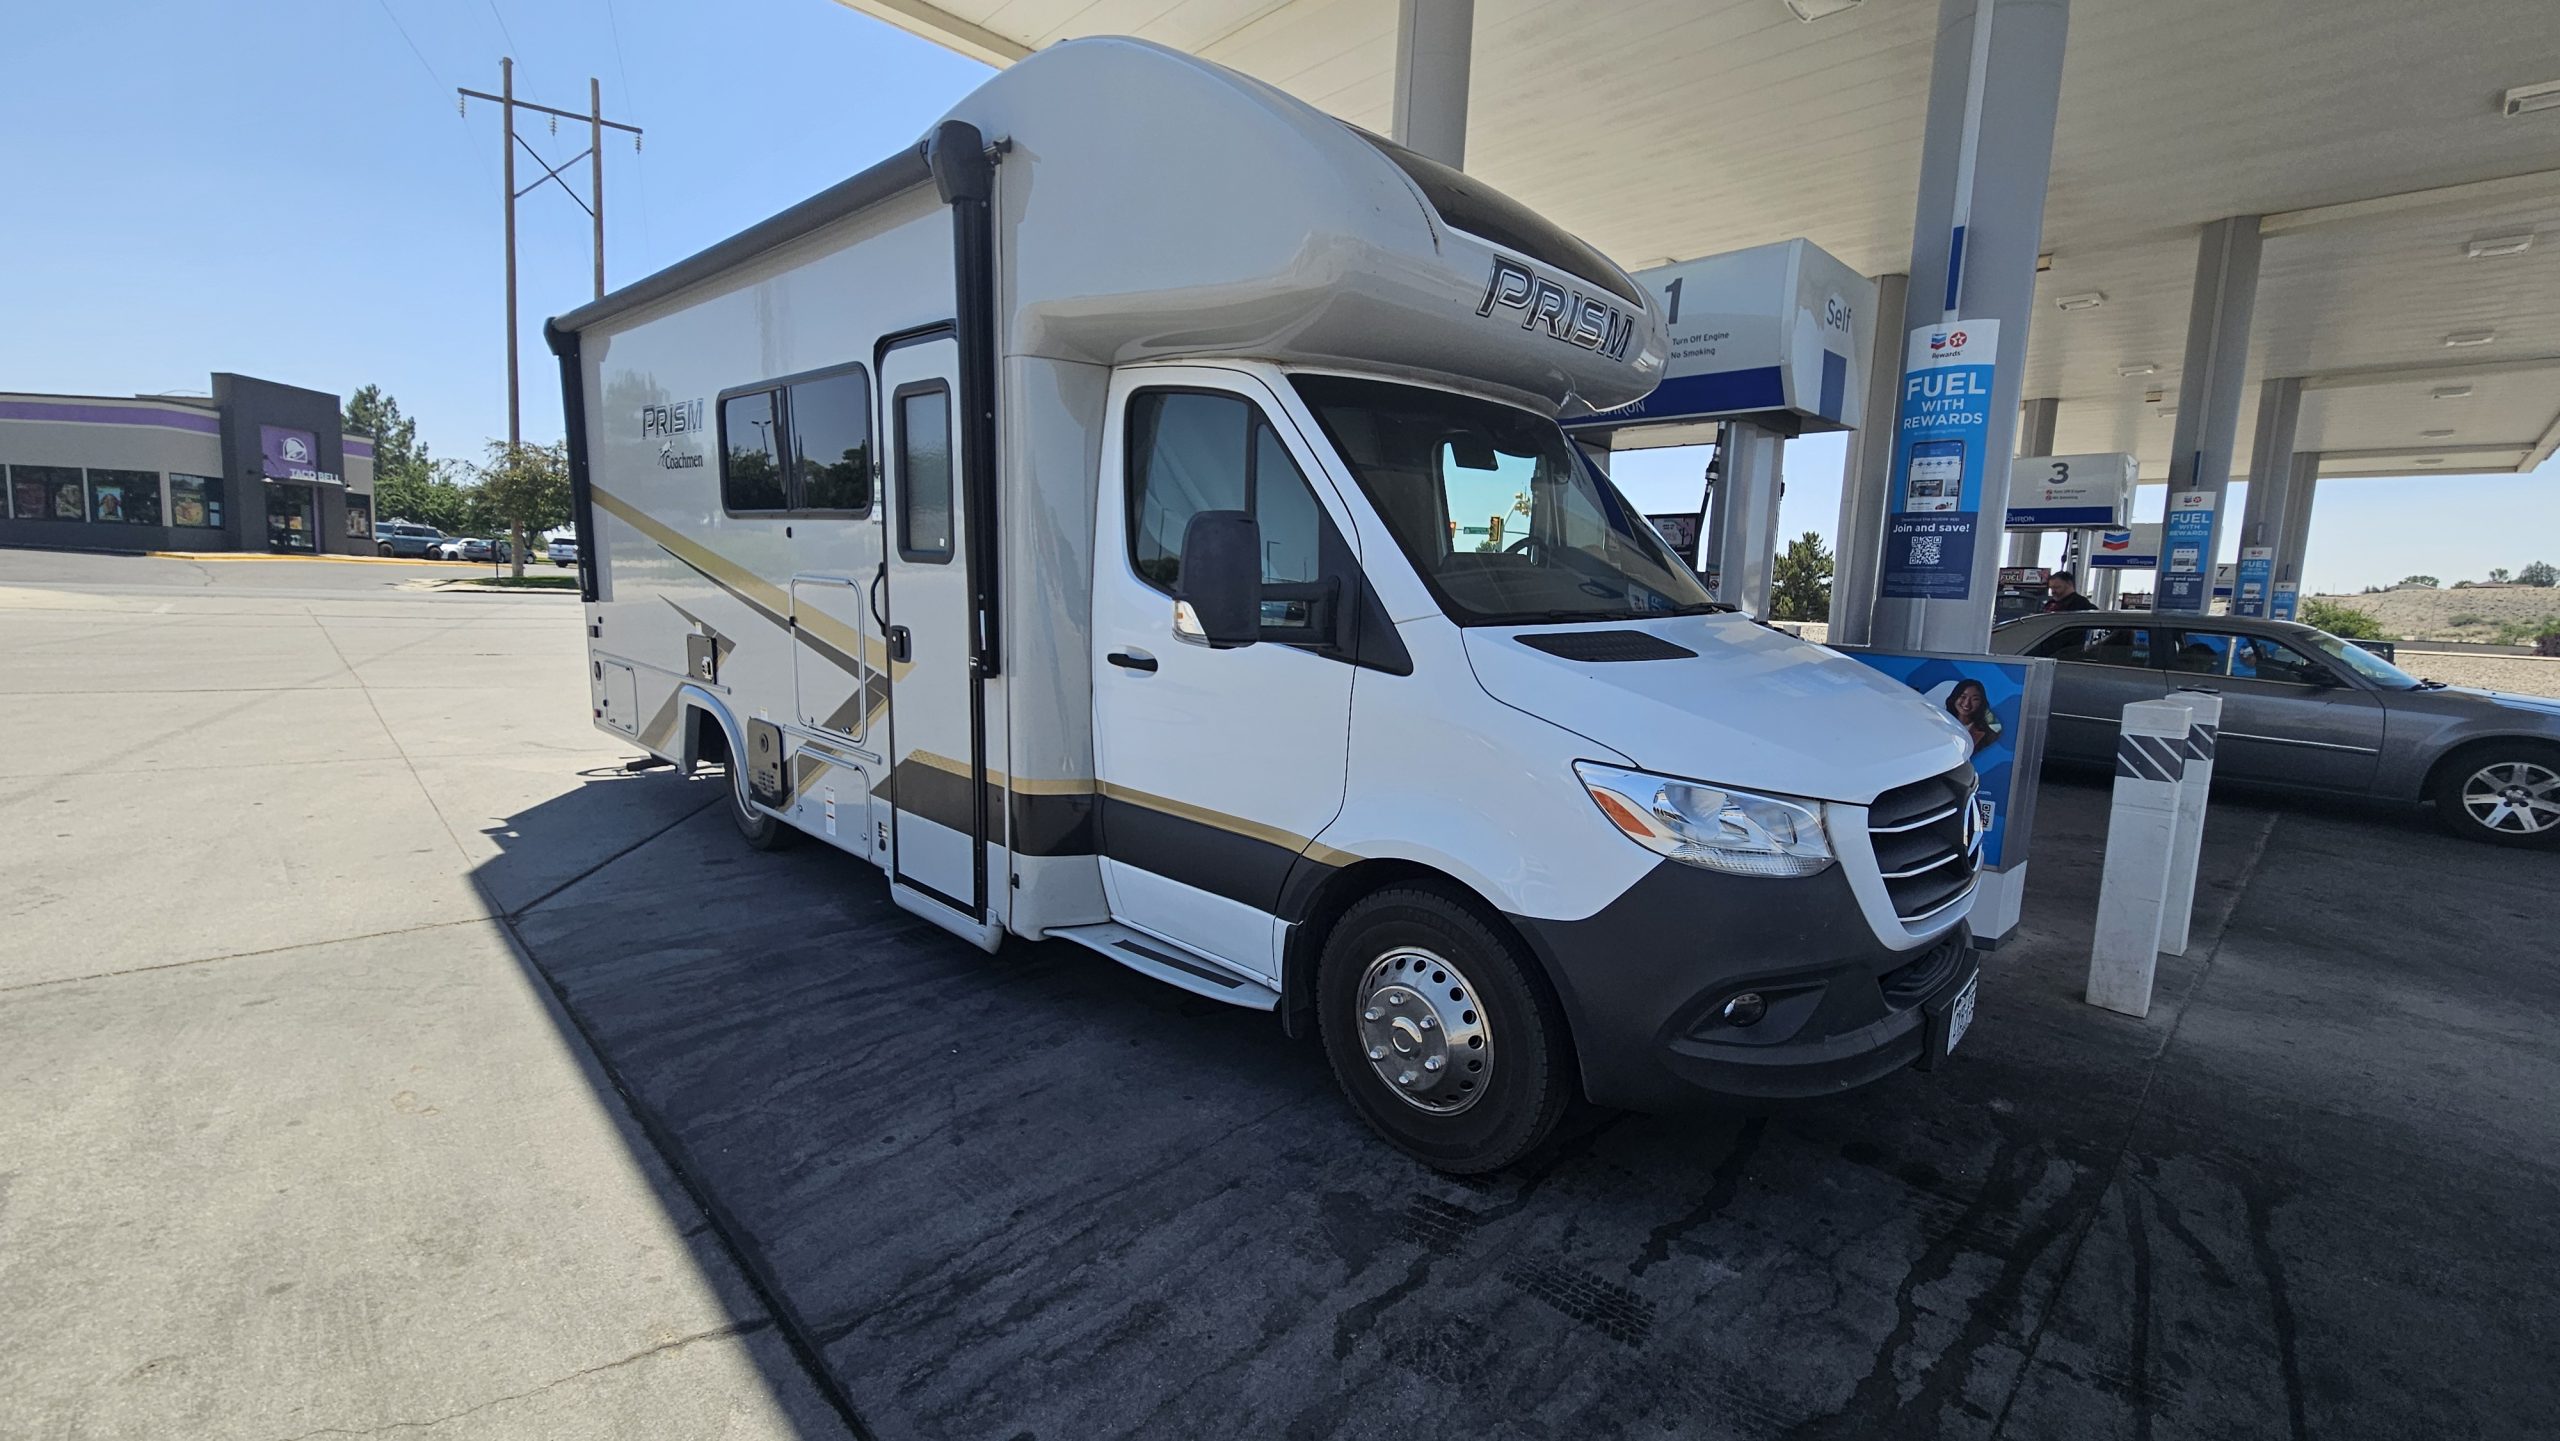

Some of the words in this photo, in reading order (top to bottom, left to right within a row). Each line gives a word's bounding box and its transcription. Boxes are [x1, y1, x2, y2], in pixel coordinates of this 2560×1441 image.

[1475, 253, 1635, 362] PRISM
[1665, 277, 1683, 325] 1
[1827, 299, 1851, 333] Self
[1672, 337, 1688, 345] Turn
[1689, 334, 1702, 343] Off
[1703, 332, 1730, 341] Engine
[1683, 347, 1716, 358] Smoking
[1906, 372, 1986, 400] FUEL
[1921, 398, 1964, 412] WITH
[642, 398, 704, 440] PRISM
[1903, 412, 1984, 429] REWARDS
[666, 452, 703, 470] Coachmen
[290, 468, 317, 480] TACO
[318, 471, 341, 483] BELL
[2048, 462, 2069, 484] 3
[2170, 513, 2210, 524] FUEL
[1893, 524, 1912, 533] Join
[1915, 523, 1935, 532] and
[1938, 524, 1970, 532] save!
[2218, 566, 2228, 577] 7
